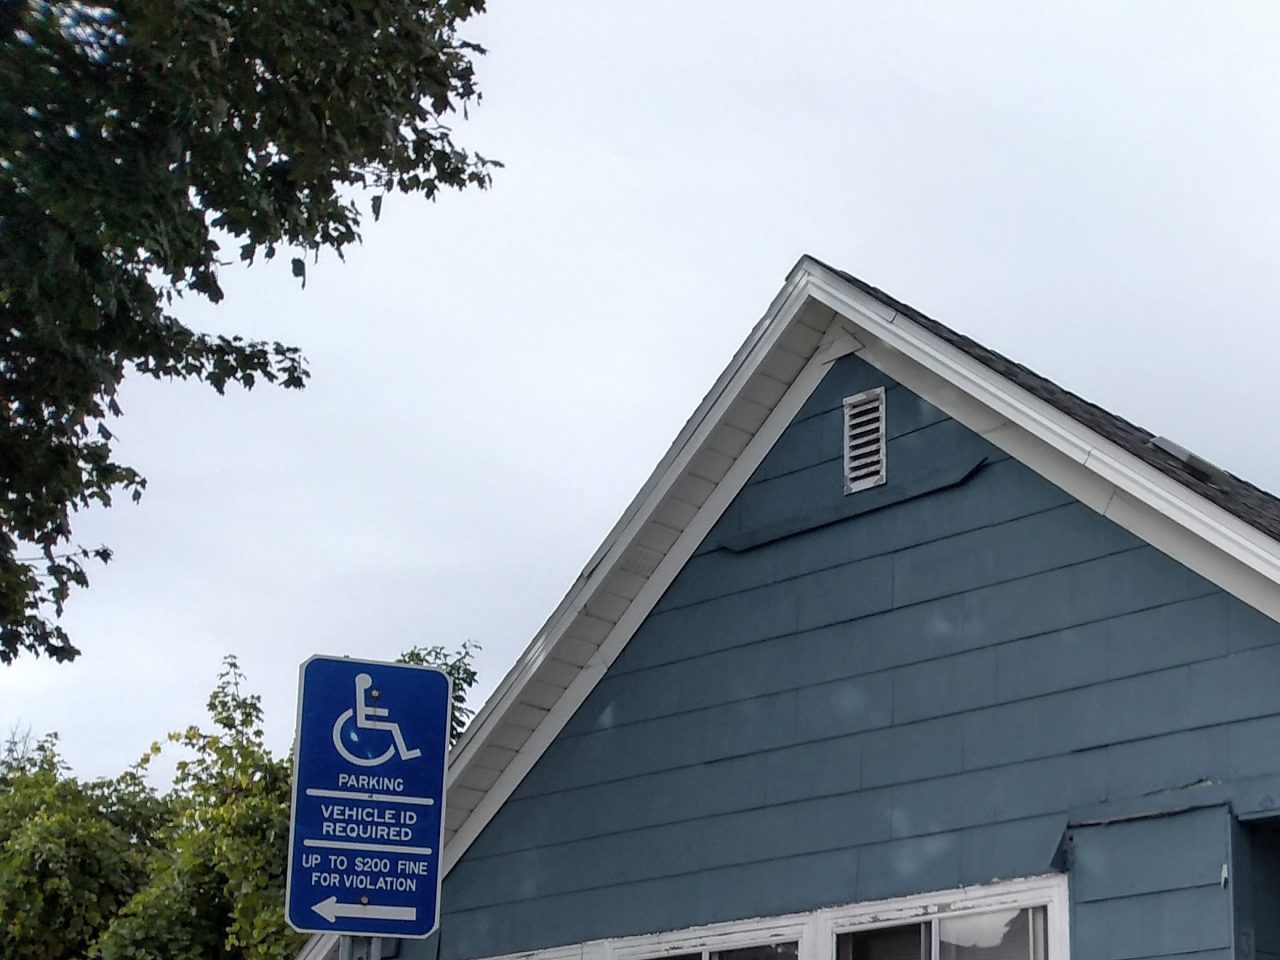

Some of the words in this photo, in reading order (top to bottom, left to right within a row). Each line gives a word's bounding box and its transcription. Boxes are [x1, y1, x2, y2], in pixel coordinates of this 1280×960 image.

[338, 773, 404, 792] PARKING
[320, 804, 396, 823] VEHICLE
[400, 810, 417, 825] ID
[322, 822, 413, 841] REQUIRED
[302, 854, 321, 868] UP
[329, 855, 348, 870] TO
[354, 856, 390, 873] $200
[397, 860, 428, 876] FINE
[311, 872, 339, 887] FOR
[343, 874, 417, 892] VIOLATION
